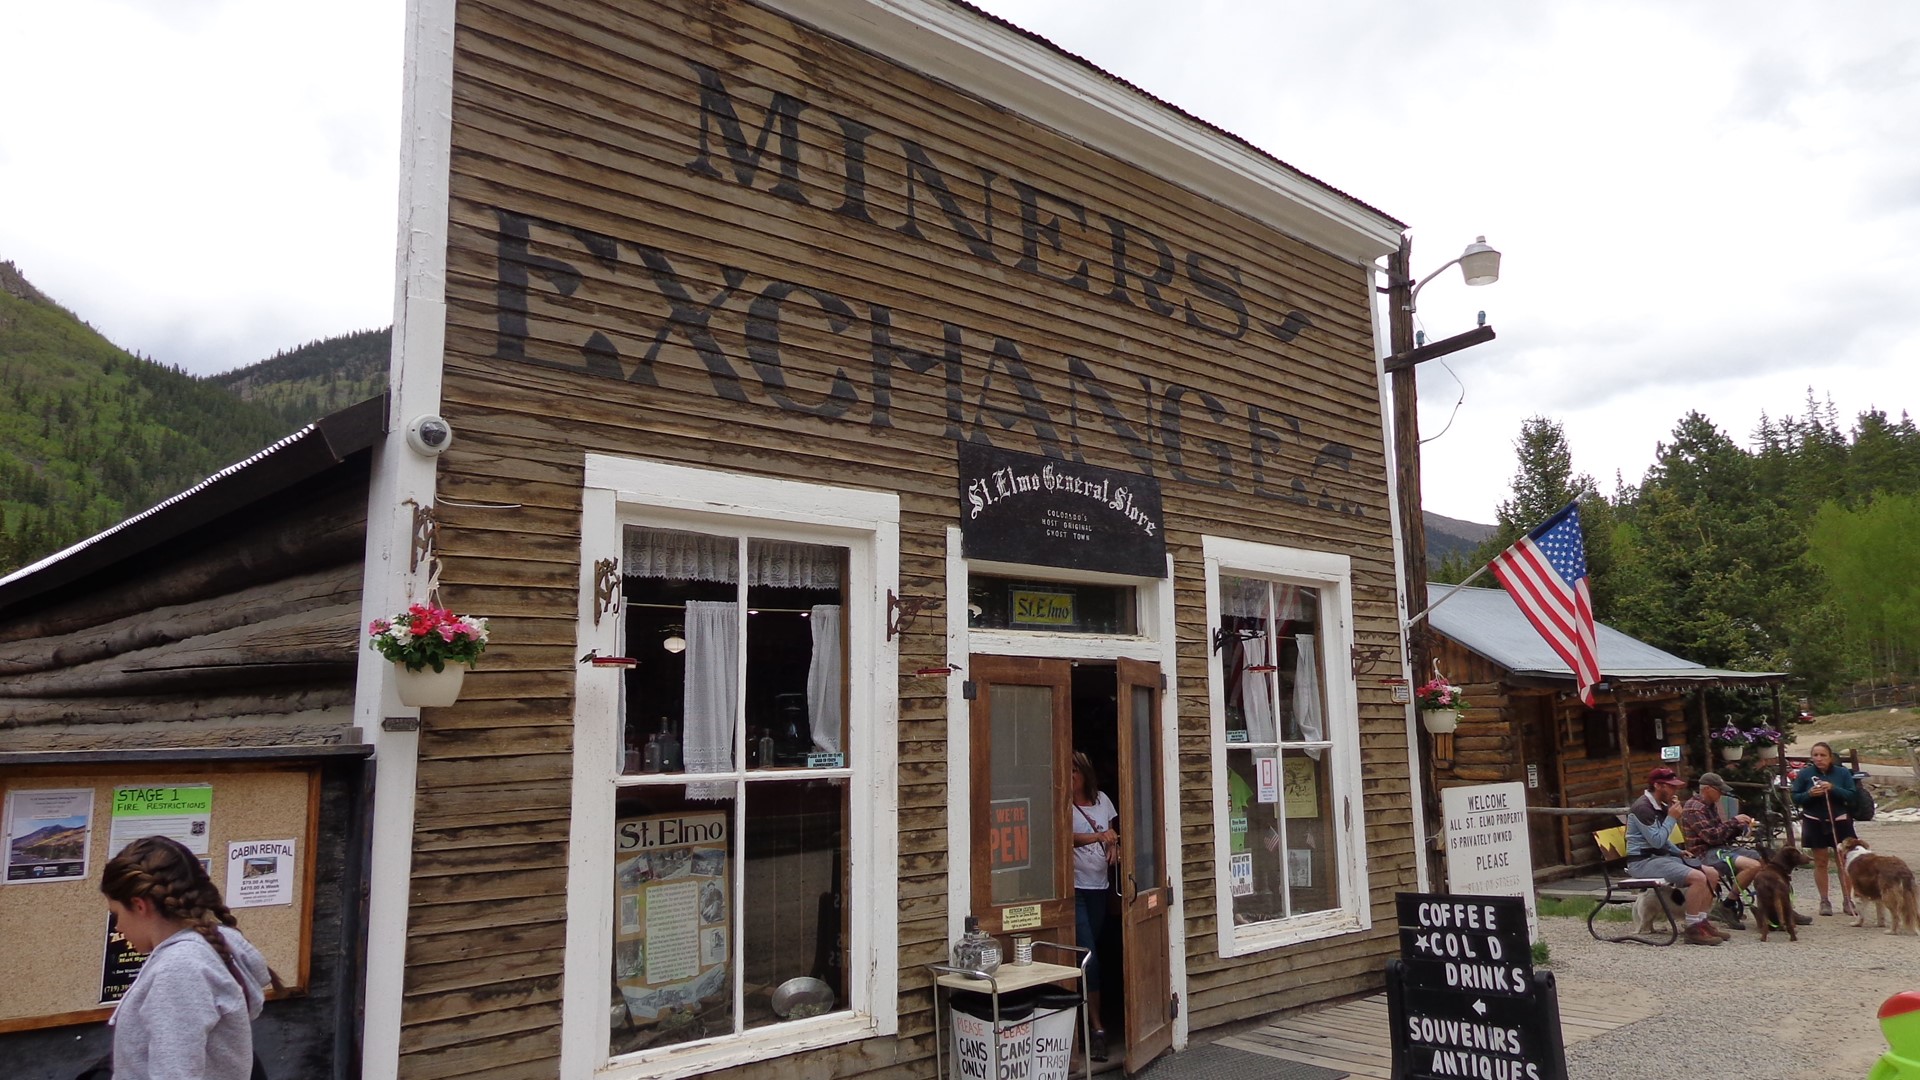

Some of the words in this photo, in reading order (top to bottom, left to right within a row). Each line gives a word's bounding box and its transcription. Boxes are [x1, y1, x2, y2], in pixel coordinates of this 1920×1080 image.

[490, 205, 1310, 506] EXCHANGE
[991, 465, 1041, 504] Elmo
[1042, 462, 1109, 503] General
[1108, 486, 1157, 538] Store
[1041, 518, 1059, 527] MOST
[1063, 522, 1093, 532] ORIGINAL
[1047, 509, 1088, 522] COLORADO'S
[1046, 529, 1067, 539] GHOST
[1072, 532, 1090, 541] TOWN
[1036, 598, 1069, 620] Elmo
[117, 788, 164, 802] STAGE
[170, 788, 180, 801] 1
[1467, 793, 1508, 811] WELCOME
[117, 803, 139, 812] FIRE
[146, 801, 206, 810] RESTRICTIONS
[996, 807, 1025, 823] WE'RE
[1450, 818, 1462, 832] ALL
[1466, 817, 1476, 830] ST.
[1479, 815, 1495, 828] ELMO
[1496, 811, 1524, 826] PROPERTY
[619, 821, 654, 849] St.
[658, 818, 724, 846] Elmo
[1450, 838, 1457, 850] IS
[1459, 833, 1491, 849] PRIVATELY
[1493, 830, 1513, 844] OWNED
[231, 845, 258, 860] CABIN
[260, 844, 293, 857] RENTAL
[991, 825, 1028, 864] PEN
[1232, 863, 1250, 878] OPEN
[1476, 852, 1509, 871] PLEASE
[1418, 902, 1497, 930] COFFEE
[1445, 962, 1526, 993] DRINKS
[957, 1017, 985, 1037] PLEASE
[1408, 1016, 1520, 1055] SOUVENIRS
[959, 1037, 988, 1061] CANS
[1000, 1036, 1031, 1062] CANS
[1035, 1038, 1069, 1053] SMALL
[962, 1058, 987, 1080] ONLY
[1000, 1059, 1031, 1080] ONLY
[1035, 1054, 1069, 1069] TRASH
[1432, 1049, 1540, 1080] ANTIQUES
